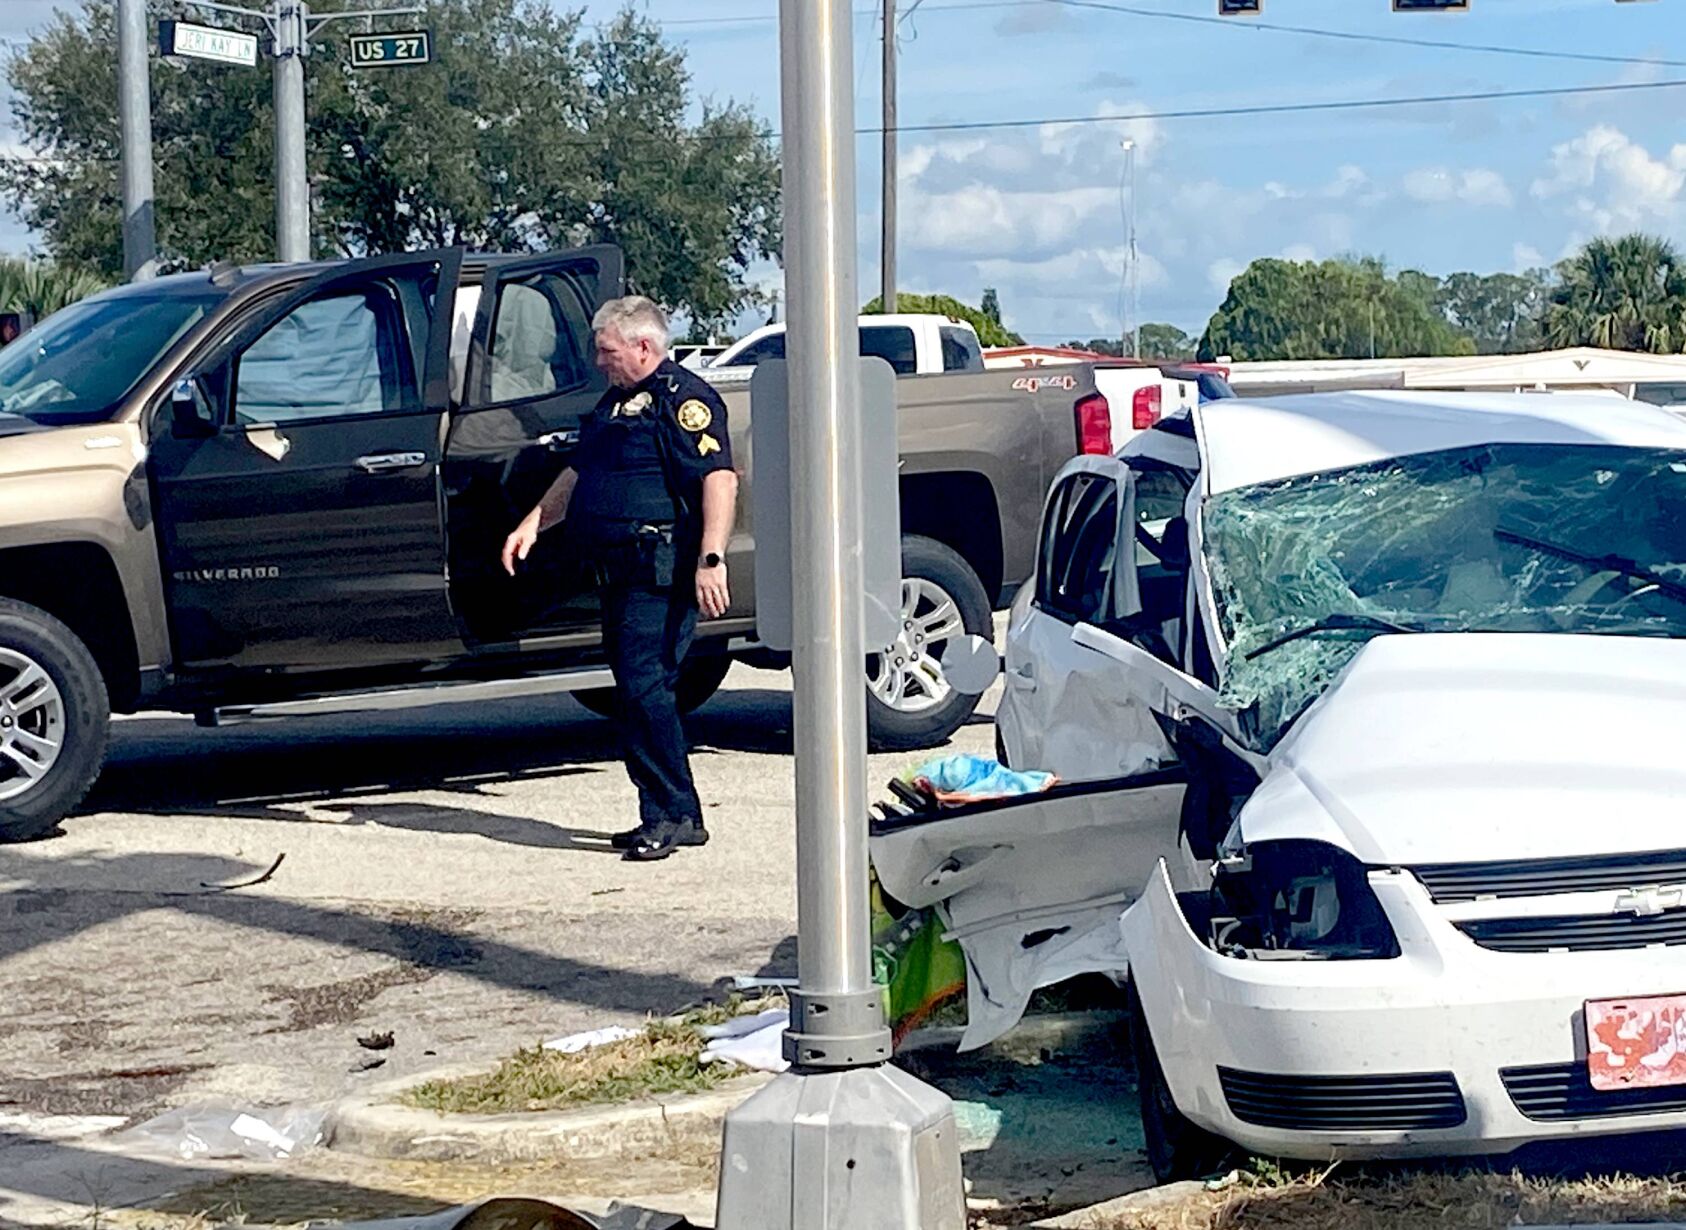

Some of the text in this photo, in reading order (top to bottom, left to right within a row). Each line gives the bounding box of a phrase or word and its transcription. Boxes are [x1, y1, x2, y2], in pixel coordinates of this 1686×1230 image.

[211, 37, 232, 54] KAY
[238, 41, 252, 57] LN
[358, 39, 419, 60] US 27
[173, 566, 279, 581] SILVERADO
